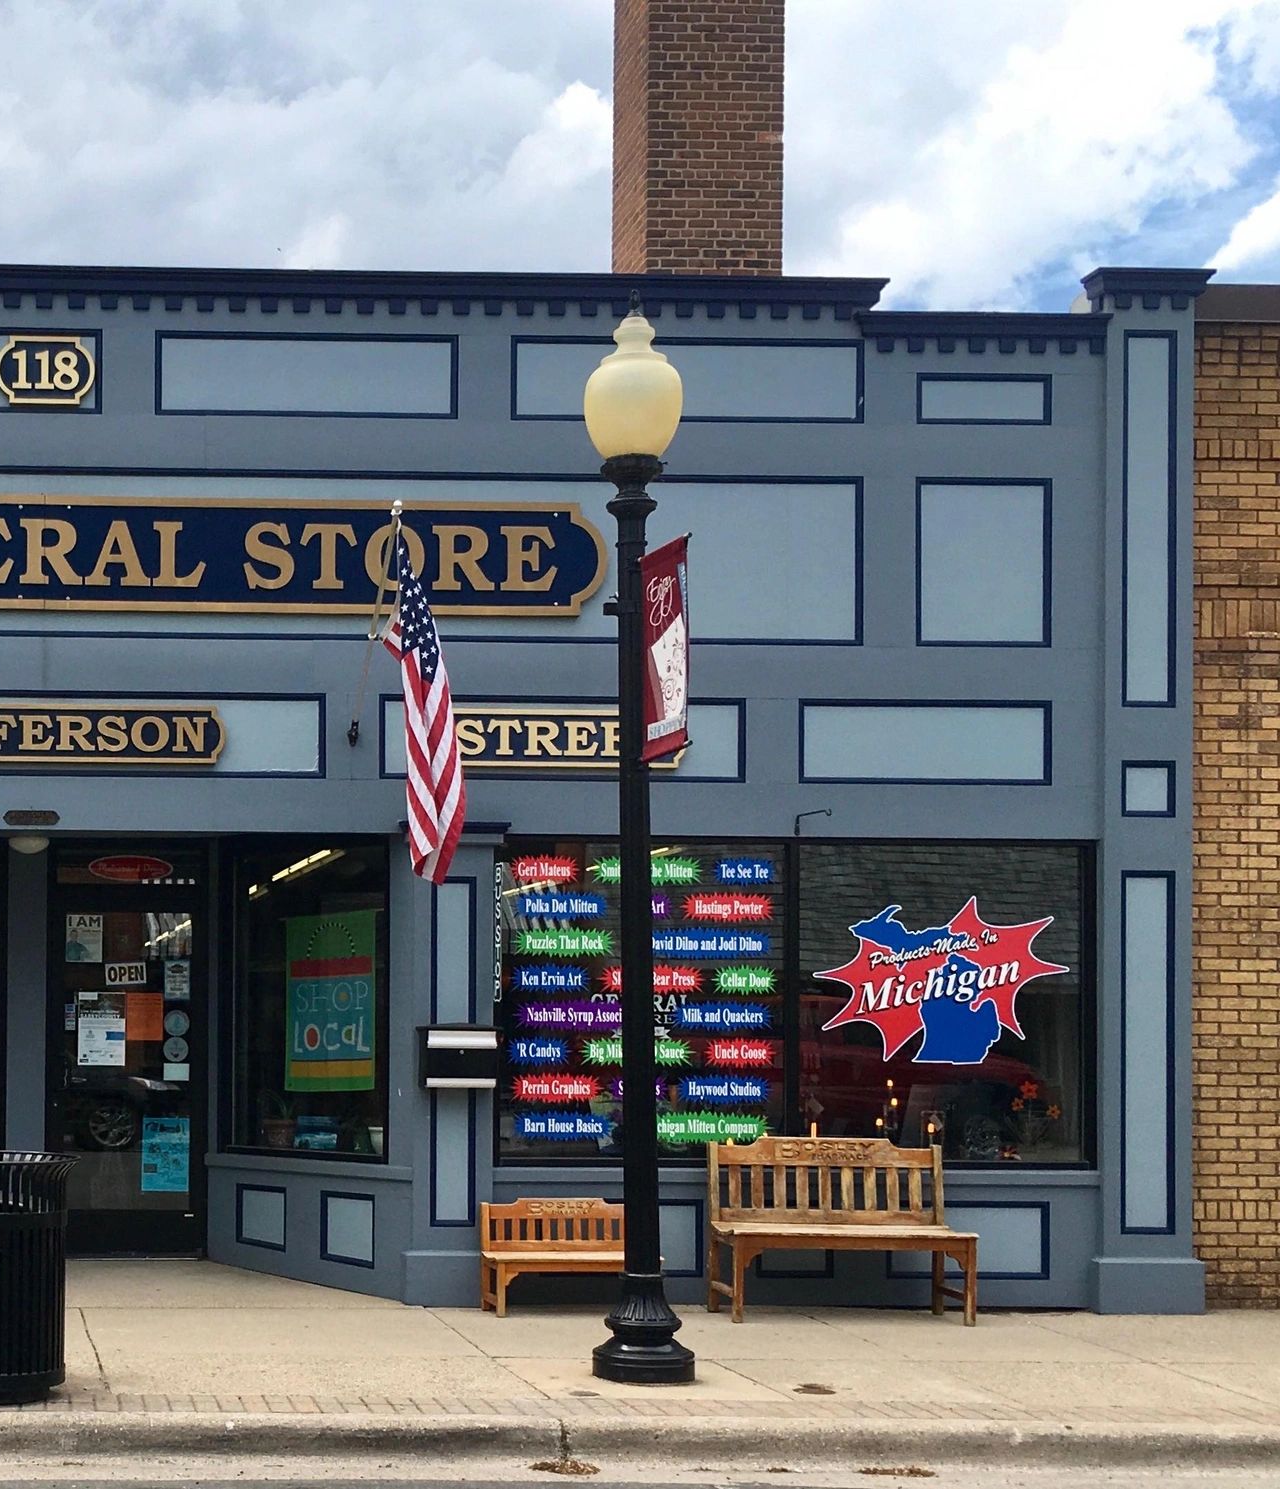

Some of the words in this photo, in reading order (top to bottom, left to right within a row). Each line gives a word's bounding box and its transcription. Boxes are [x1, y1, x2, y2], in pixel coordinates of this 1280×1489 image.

[12, 349, 80, 391] 118
[242, 521, 559, 592] STORE
[518, 862, 537, 876] Geri
[540, 863, 570, 876] Mateus
[667, 864, 693, 877] Mitten
[721, 864, 735, 878] Tee
[738, 864, 751, 878] See
[754, 865, 768, 878] Tee
[526, 899, 549, 912] Polka
[552, 899, 567, 913] Dot
[570, 899, 597, 913] Mitten
[696, 900, 731, 918] Hastings
[734, 901, 763, 914] Pewter
[76, 915, 101, 928] AM
[527, 935, 557, 949] Puzzles
[559, 936, 579, 949] That
[582, 936, 603, 949] Rock
[676, 937, 698, 950] Dilno
[701, 937, 716, 950] and
[719, 937, 736, 950] Jodi
[739, 937, 762, 951] Dilno
[980, 929, 999, 945] In
[107, 965, 144, 983] OPEN
[522, 972, 538, 985] Ken
[542, 972, 564, 985] Ervin
[567, 973, 581, 985] Art
[673, 972, 694, 986] Press
[721, 973, 747, 987] Cellar
[750, 973, 770, 987] Door
[856, 960, 1020, 1014] Michigan
[295, 981, 369, 1013] SHOP
[527, 1008, 569, 1022] Nashville
[569, 1008, 593, 1025] Syrup
[683, 1009, 702, 1022] Milk
[705, 1009, 720, 1022] and
[723, 1009, 763, 1026] Quackers
[529, 1043, 560, 1061] Candys
[590, 1044, 604, 1062] Big
[660, 1045, 684, 1058] Sauce
[715, 1045, 738, 1058] Uncle
[741, 1045, 766, 1059] Goose
[523, 1080, 549, 1094] Perrin
[552, 1080, 590, 1098] Graphics
[689, 1082, 727, 1099] Haywood
[730, 1082, 761, 1096] Studios
[525, 1119, 545, 1132] Barn
[548, 1119, 574, 1132] House
[577, 1119, 602, 1133] Basics
[688, 1120, 715, 1133] Mitten
[718, 1120, 759, 1138] Company
